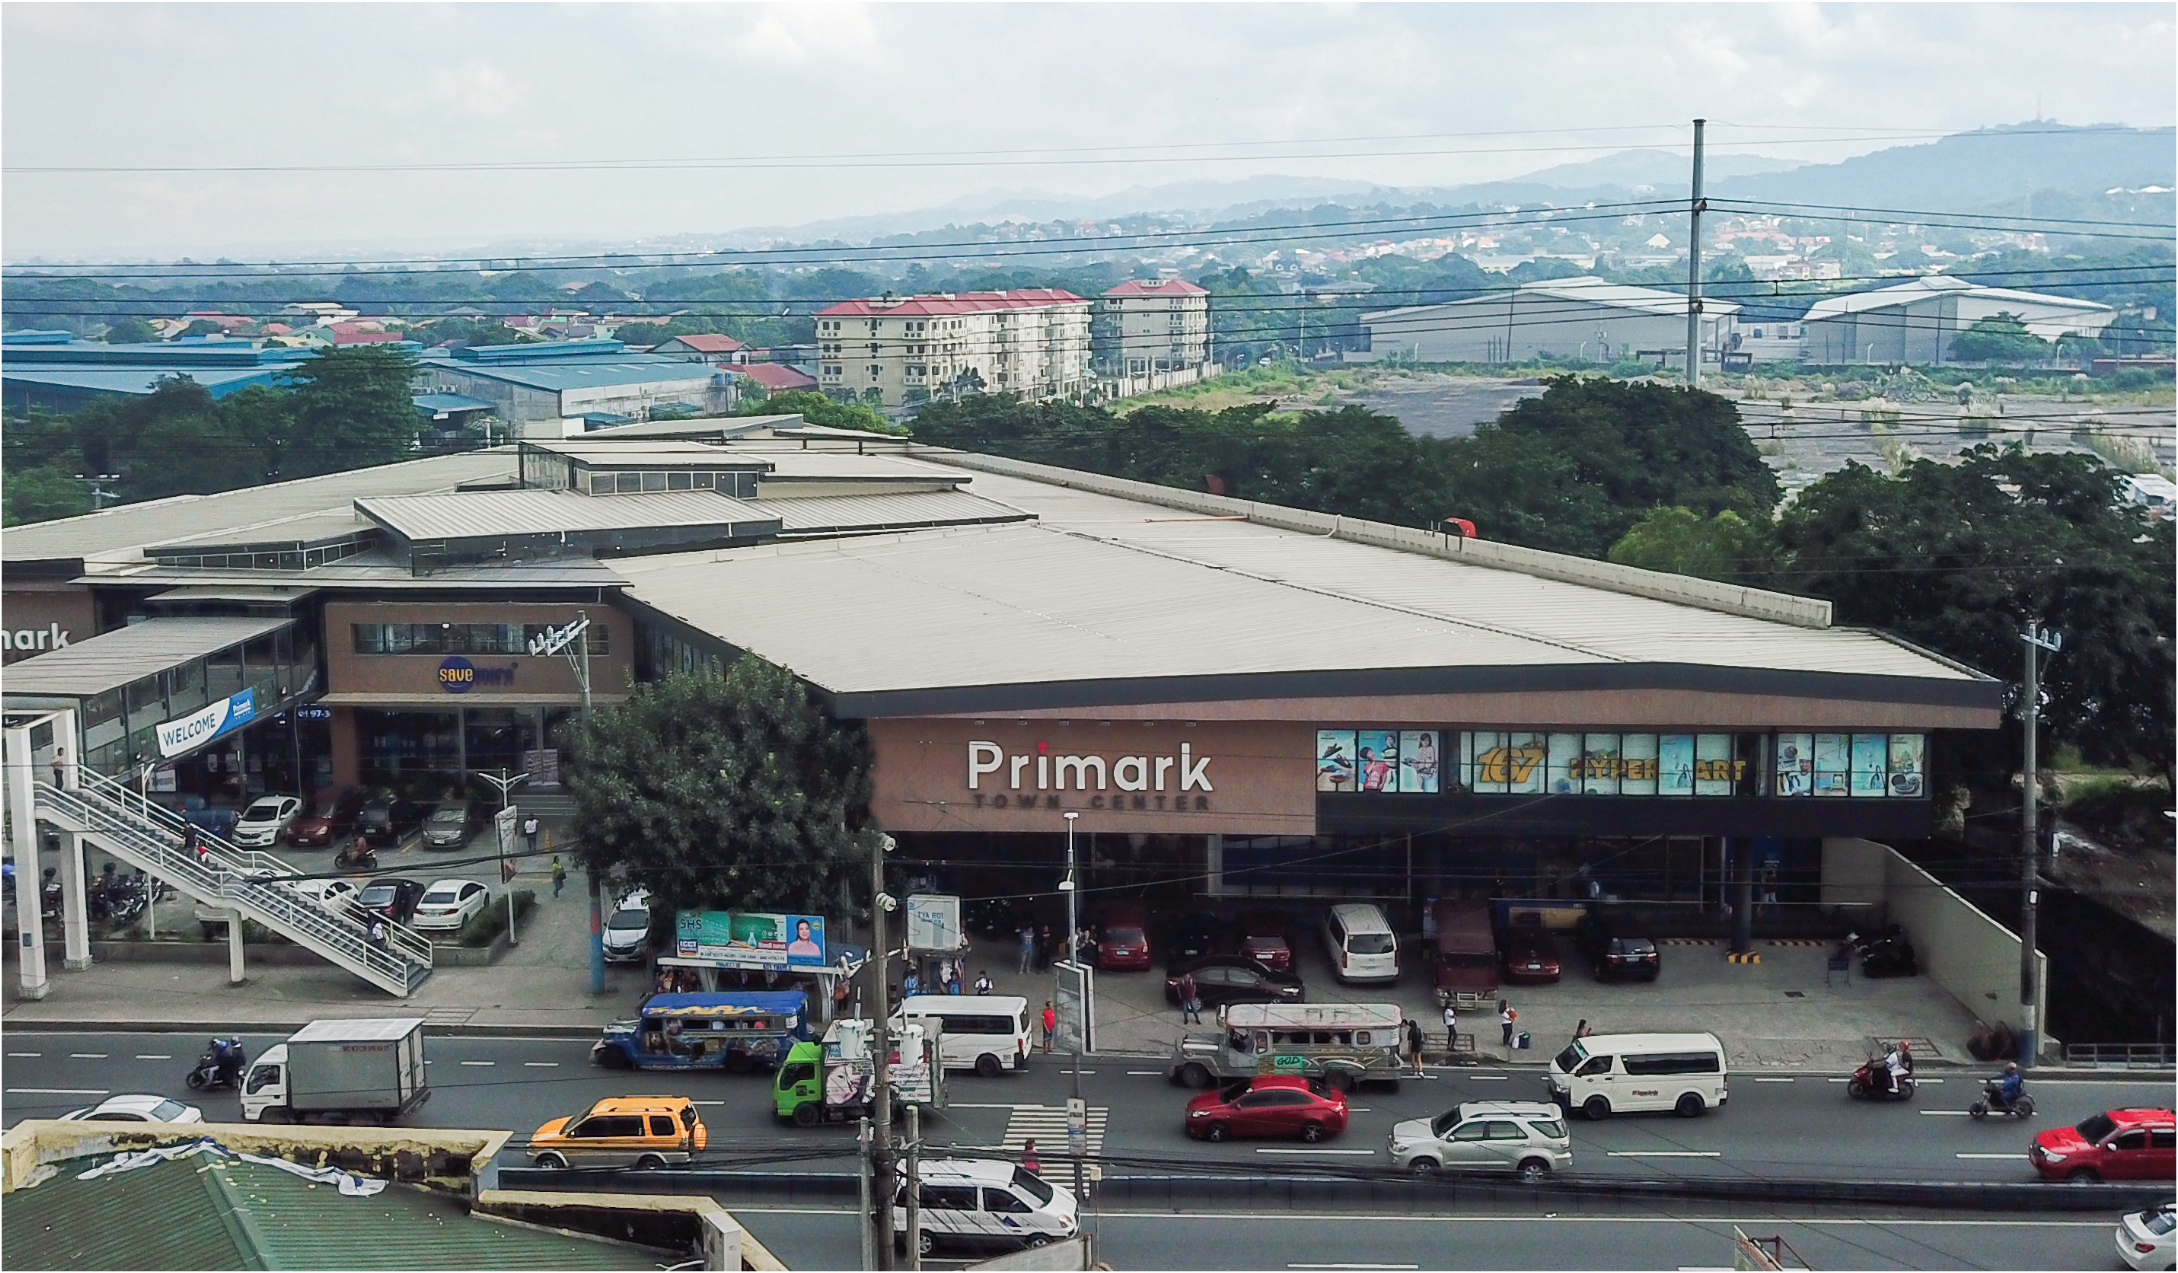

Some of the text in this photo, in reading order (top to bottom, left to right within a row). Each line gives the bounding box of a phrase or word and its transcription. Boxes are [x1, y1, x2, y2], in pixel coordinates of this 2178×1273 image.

[163, 713, 216, 747] WELCOME
[968, 740, 1214, 792] Primark
[1478, 747, 1545, 783] 167
[973, 794, 1210, 811] TOWN CENTER
[680, 918, 702, 930] SHS
